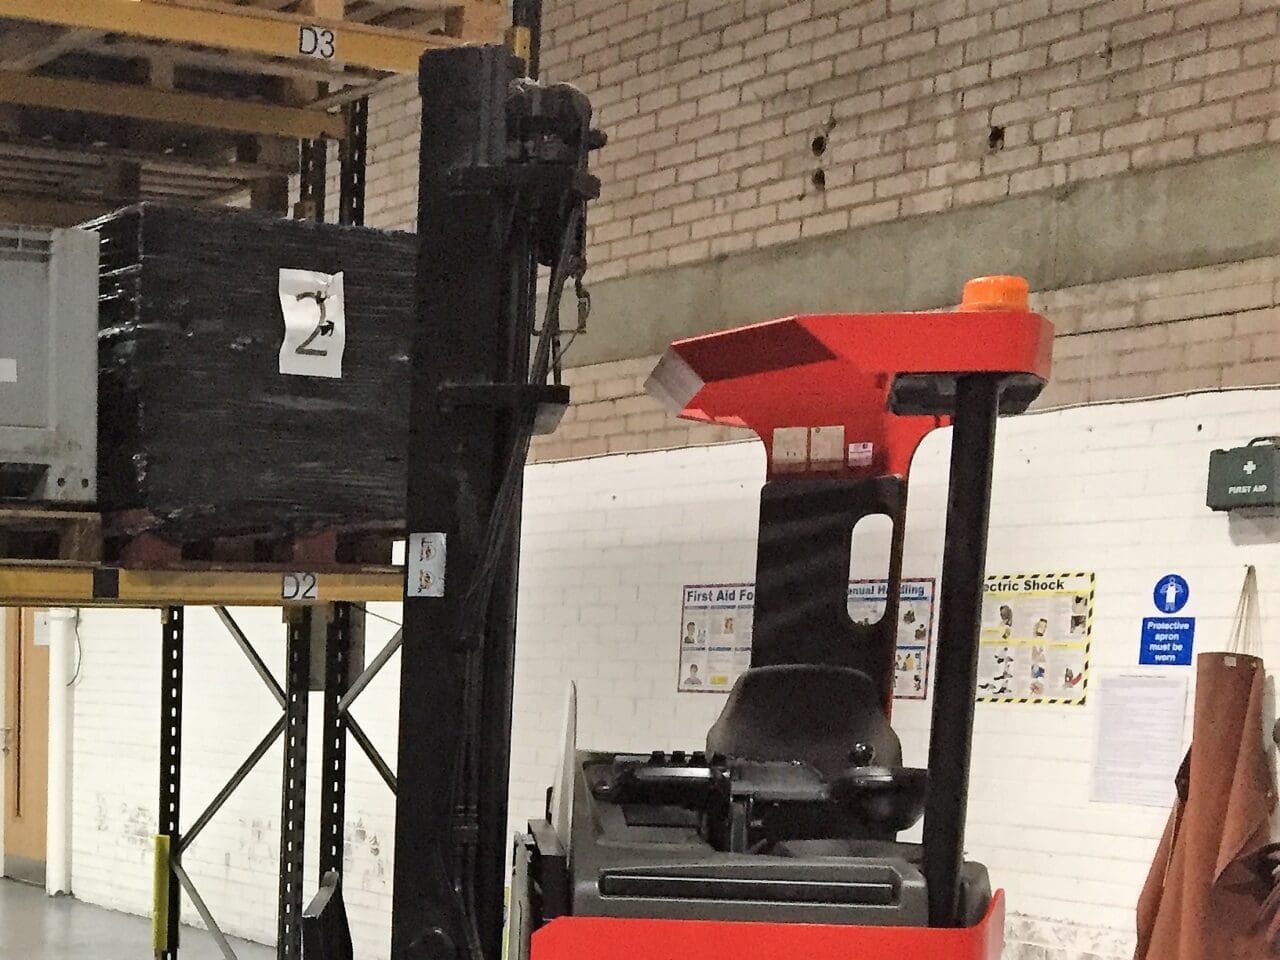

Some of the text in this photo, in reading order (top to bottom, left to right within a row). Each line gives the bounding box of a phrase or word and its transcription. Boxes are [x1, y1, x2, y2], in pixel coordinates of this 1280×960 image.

[299, 26, 334, 58] D3
[295, 290, 328, 357] 2
[1228, 484, 1268, 494] FIRST AID
[281, 572, 316, 599] D2
[982, 579, 1064, 592] ectric Shock
[687, 590, 713, 602] First
[716, 590, 736, 601] Aid
[1147, 621, 1190, 630] Protective
[1155, 633, 1180, 642] apron
[1149, 643, 1183, 652] must be
[1154, 654, 1176, 662] worn
